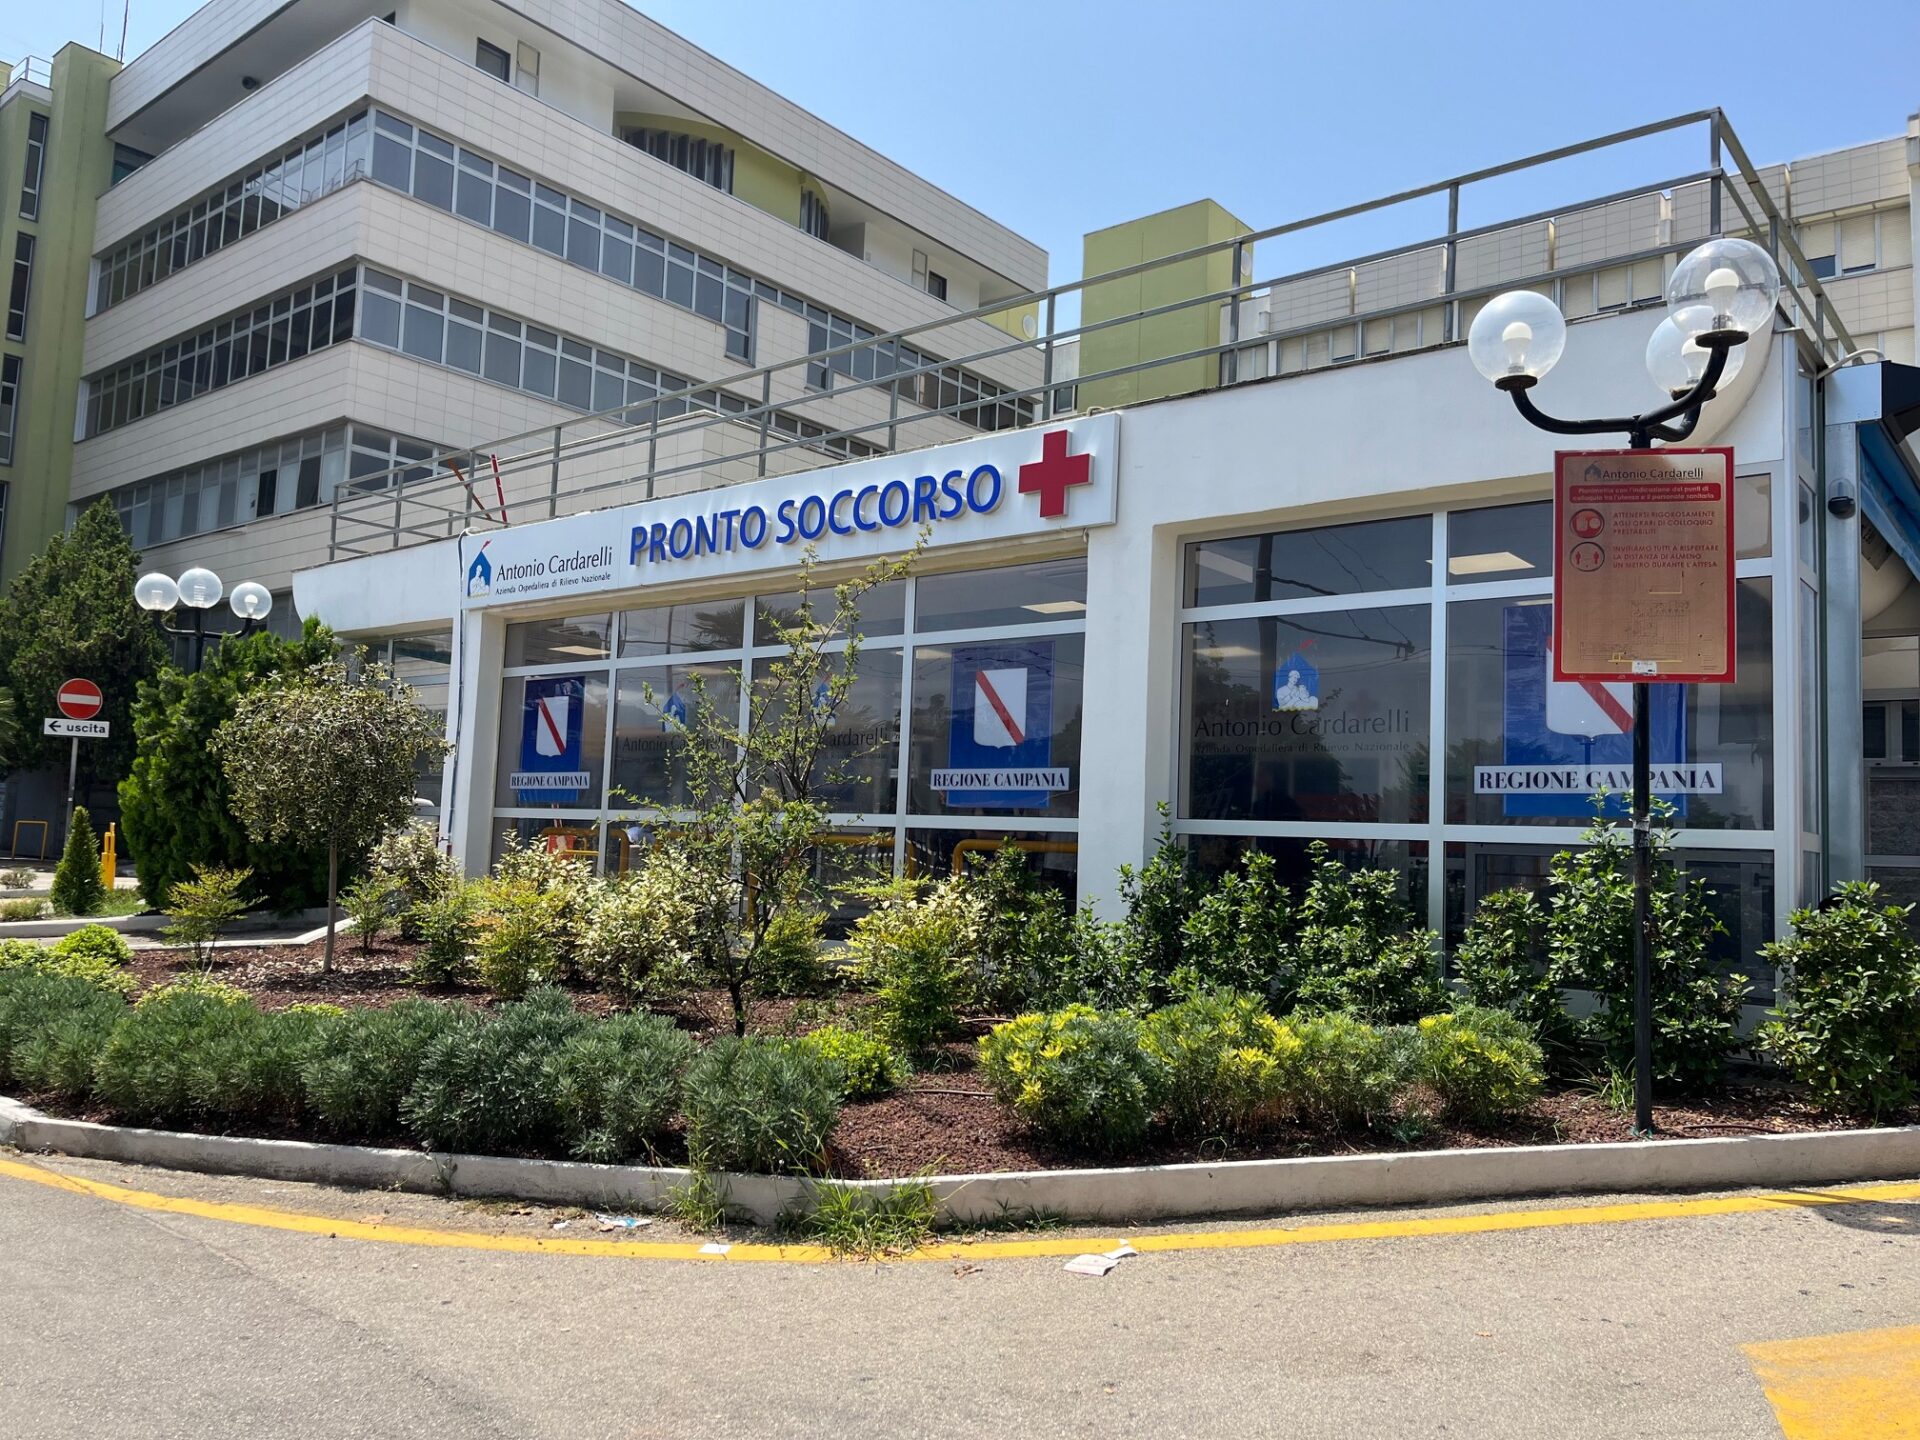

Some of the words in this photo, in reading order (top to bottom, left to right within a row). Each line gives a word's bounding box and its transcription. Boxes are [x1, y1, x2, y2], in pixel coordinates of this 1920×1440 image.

[1602, 469, 1647, 479] Antonio
[1650, 468, 1704, 479] Cardarelli
[629, 505, 770, 566] PRONTO
[775, 464, 1004, 544] SOCCORSO
[496, 559, 545, 582] Antonio
[549, 546, 612, 574] Cardarelli
[496, 585, 516, 595] Azienda
[518, 582, 549, 594] Ospedaliera
[551, 579, 557, 588] di
[560, 577, 579, 587] Rilievo
[581, 572, 611, 583] Nazionale
[67, 724, 106, 734] uscita
[1194, 714, 1282, 737] Antonio
[1290, 708, 1409, 736] Cardarelli
[622, 735, 668, 752] Antonio
[511, 775, 546, 787] REGIONE
[547, 775, 588, 787] CAMPANIA
[933, 773, 990, 787] REGIONE
[994, 772, 1065, 787] CAMPANIA
[1479, 770, 1579, 790] REGIONE
